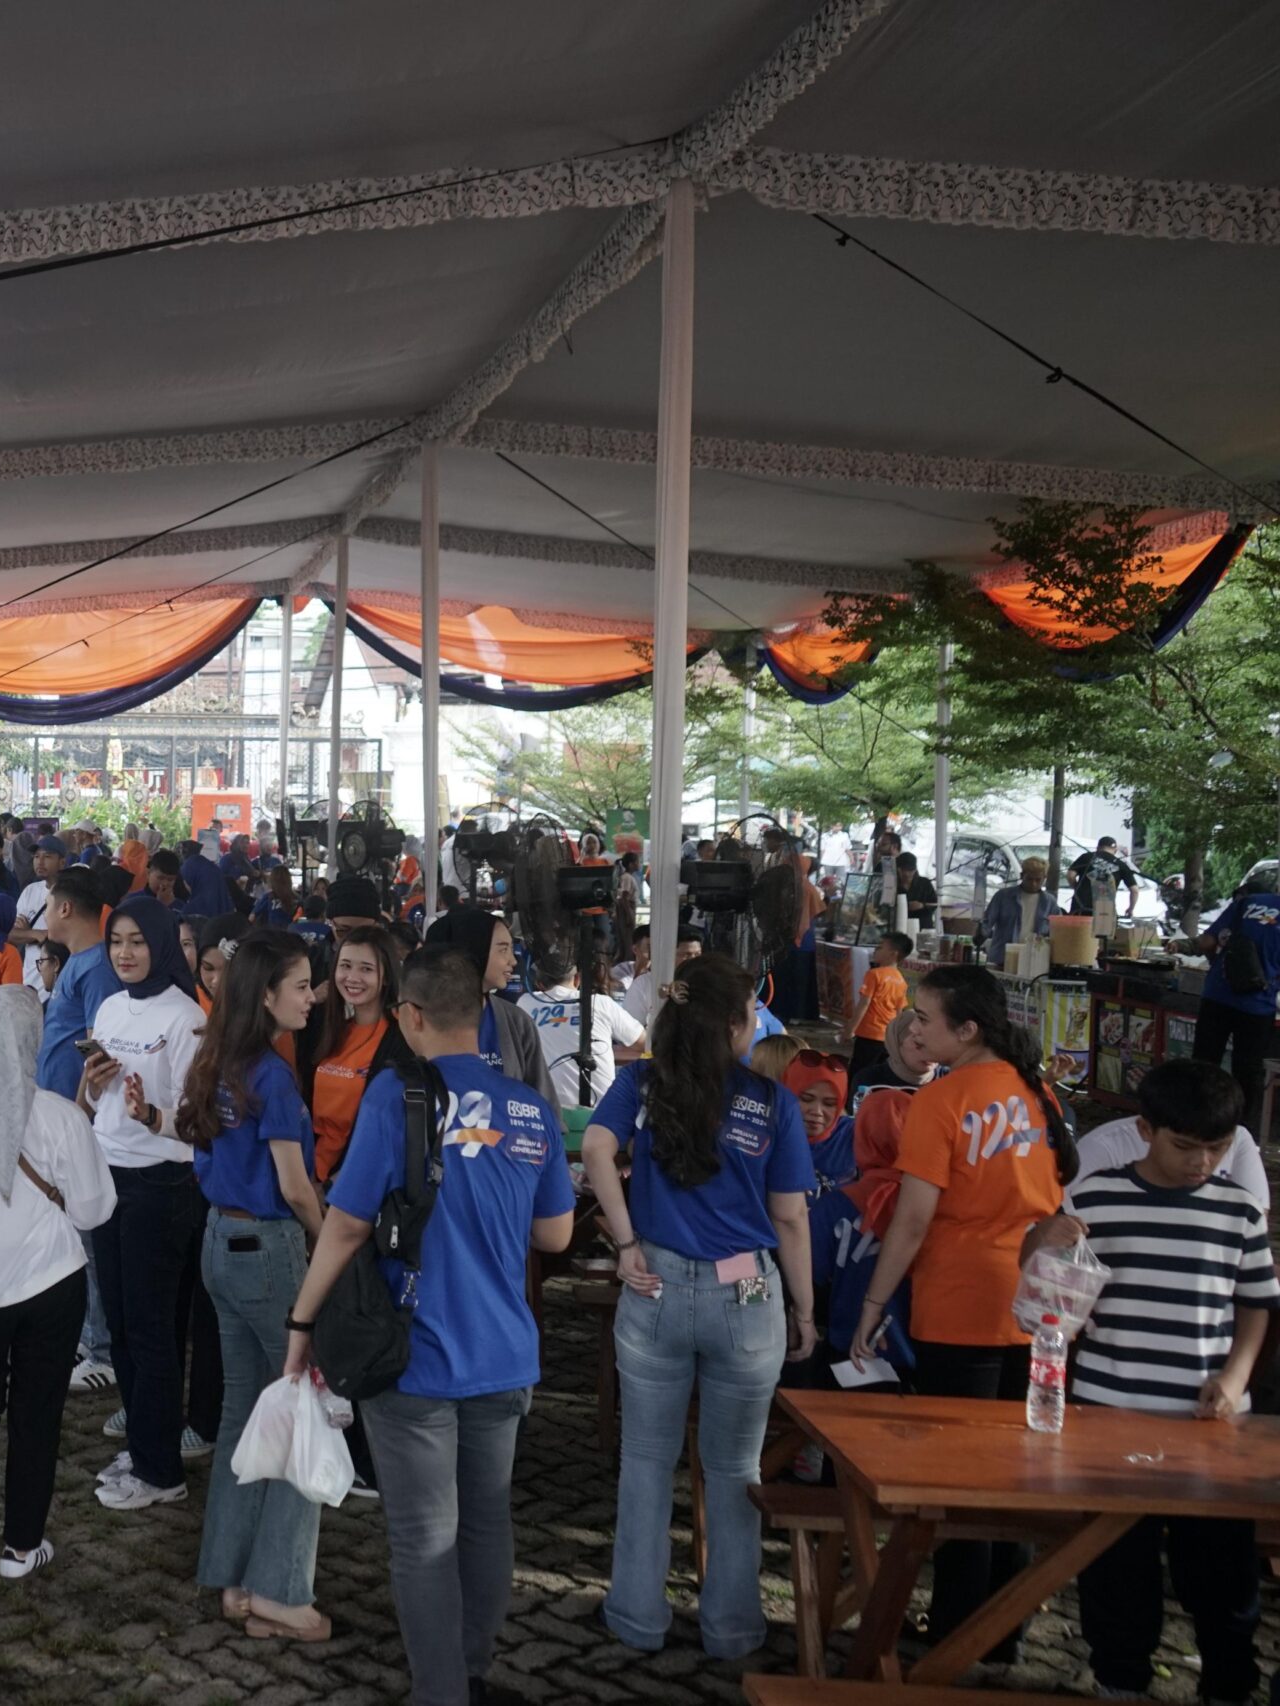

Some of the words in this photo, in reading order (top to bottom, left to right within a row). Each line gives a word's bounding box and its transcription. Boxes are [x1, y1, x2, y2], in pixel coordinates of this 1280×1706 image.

[531, 1004, 568, 1027] 129
[747, 1099, 771, 1118] BRI
[962, 1095, 1041, 1167] 129
